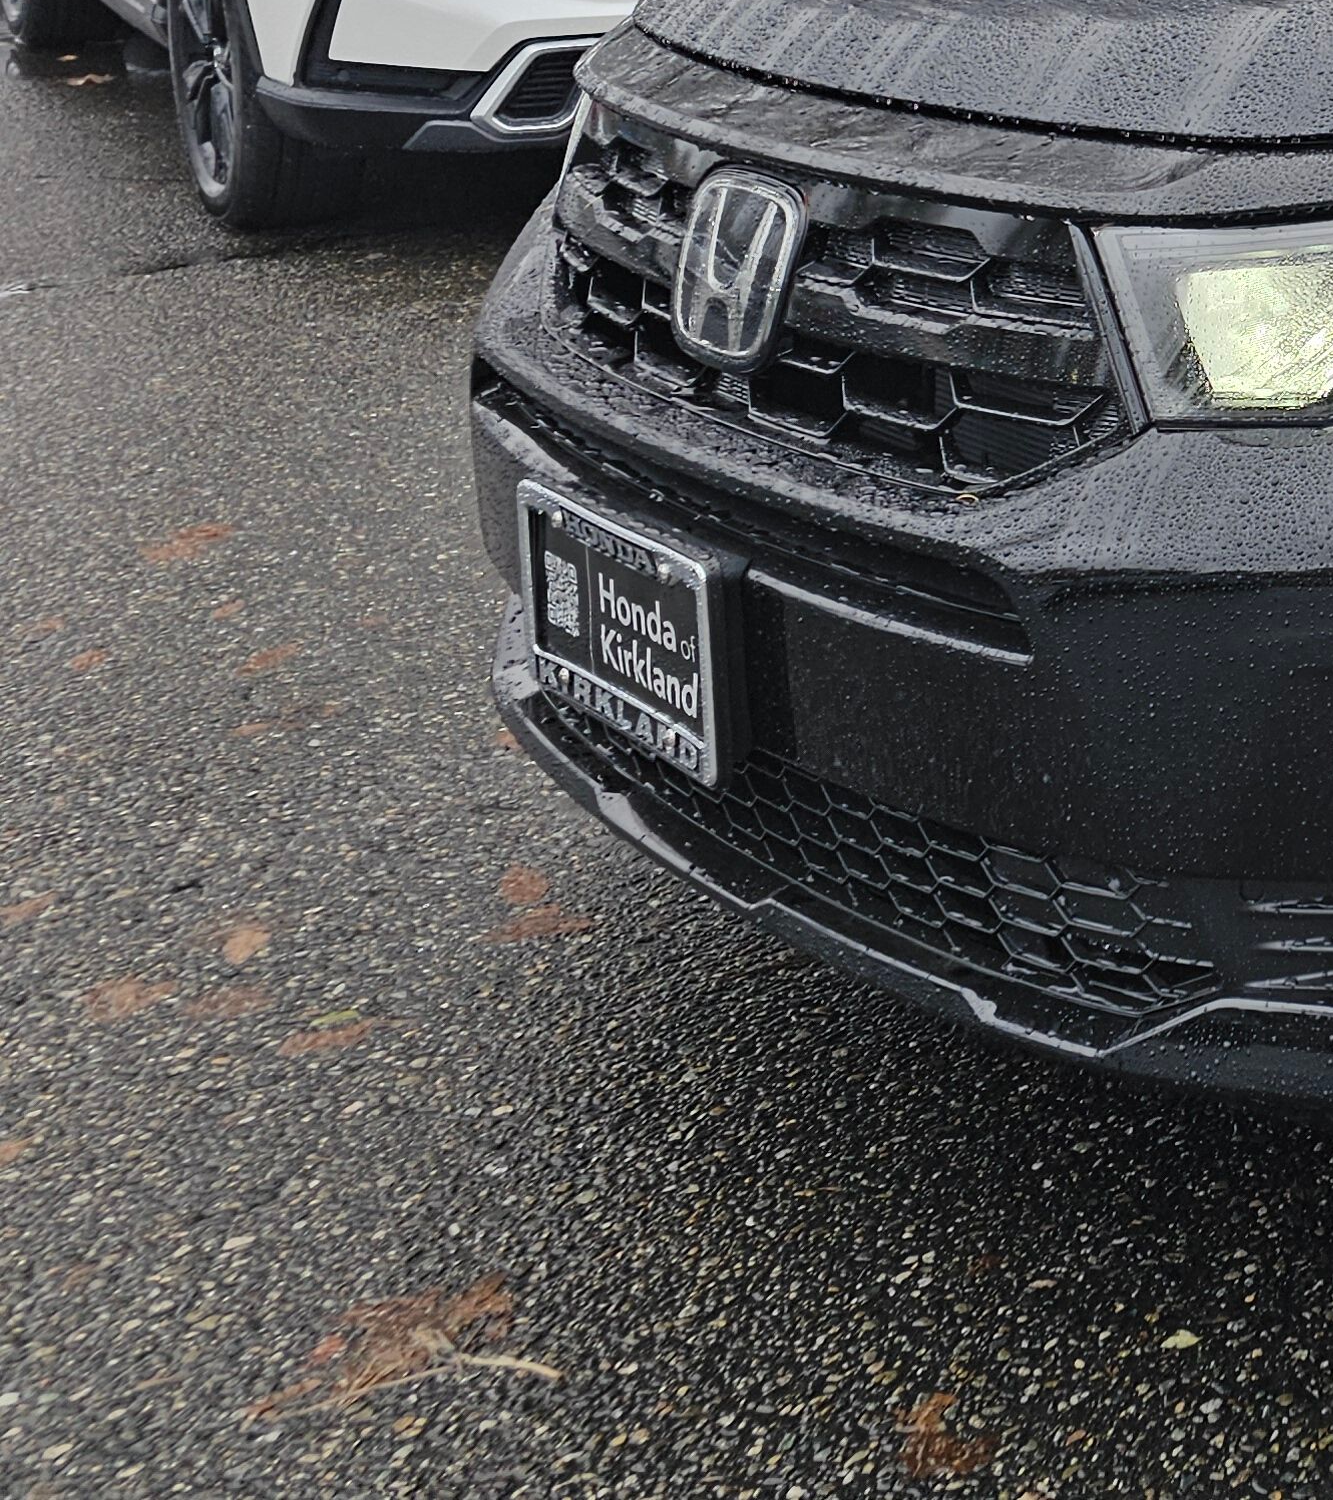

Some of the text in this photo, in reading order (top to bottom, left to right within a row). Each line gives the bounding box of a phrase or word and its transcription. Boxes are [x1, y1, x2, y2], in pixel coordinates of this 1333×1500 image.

[562, 507, 658, 577] HONDA
[598, 572, 696, 663] Honda of
[538, 656, 698, 771] KIRKLAND
[600, 623, 699, 719] Kirkland
